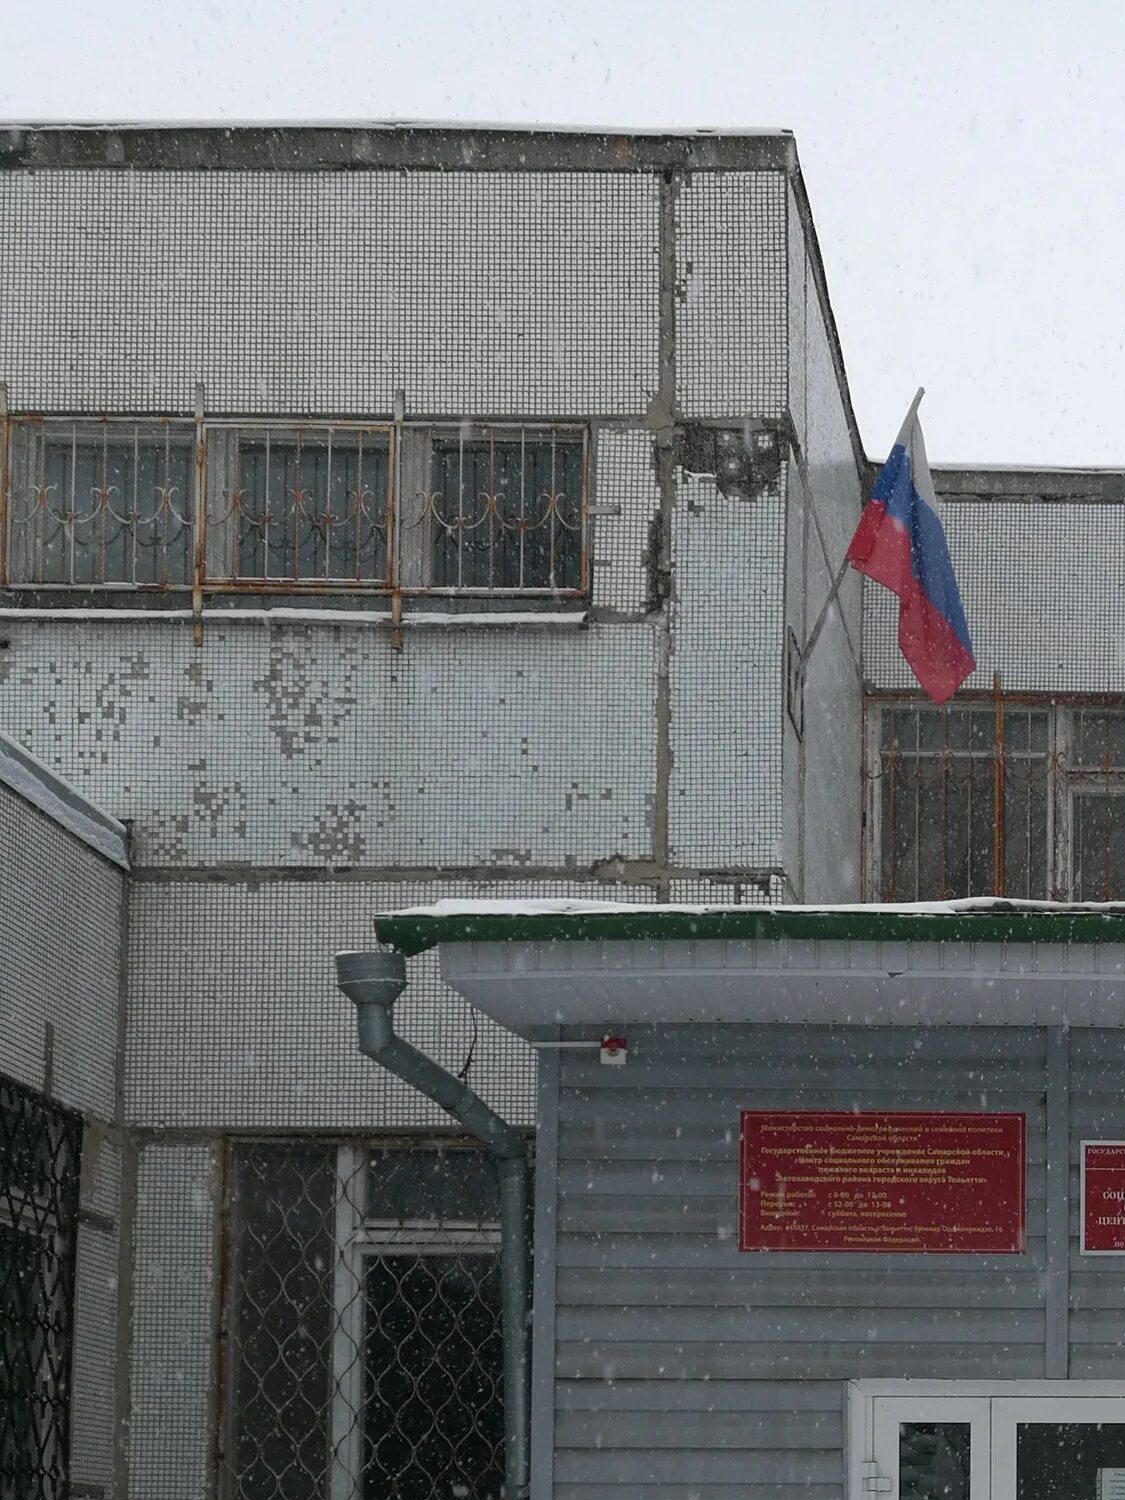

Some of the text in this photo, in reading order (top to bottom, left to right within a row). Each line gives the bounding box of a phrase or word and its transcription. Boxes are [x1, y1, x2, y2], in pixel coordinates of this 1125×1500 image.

[877, 1148, 926, 1157] учреждение
[927, 1147, 970, 1157] Самарской
[824, 1157, 876, 1165] социального
[877, 1157, 935, 1166] обслуживания
[936, 1158, 971, 1167] граждан
[859, 1167, 895, 1175] возраста
[902, 1167, 947, 1176] инвалидов
[842, 1175, 872, 1184] района
[873, 1176, 918, 1184] городского
[919, 1175, 946, 1185] округа
